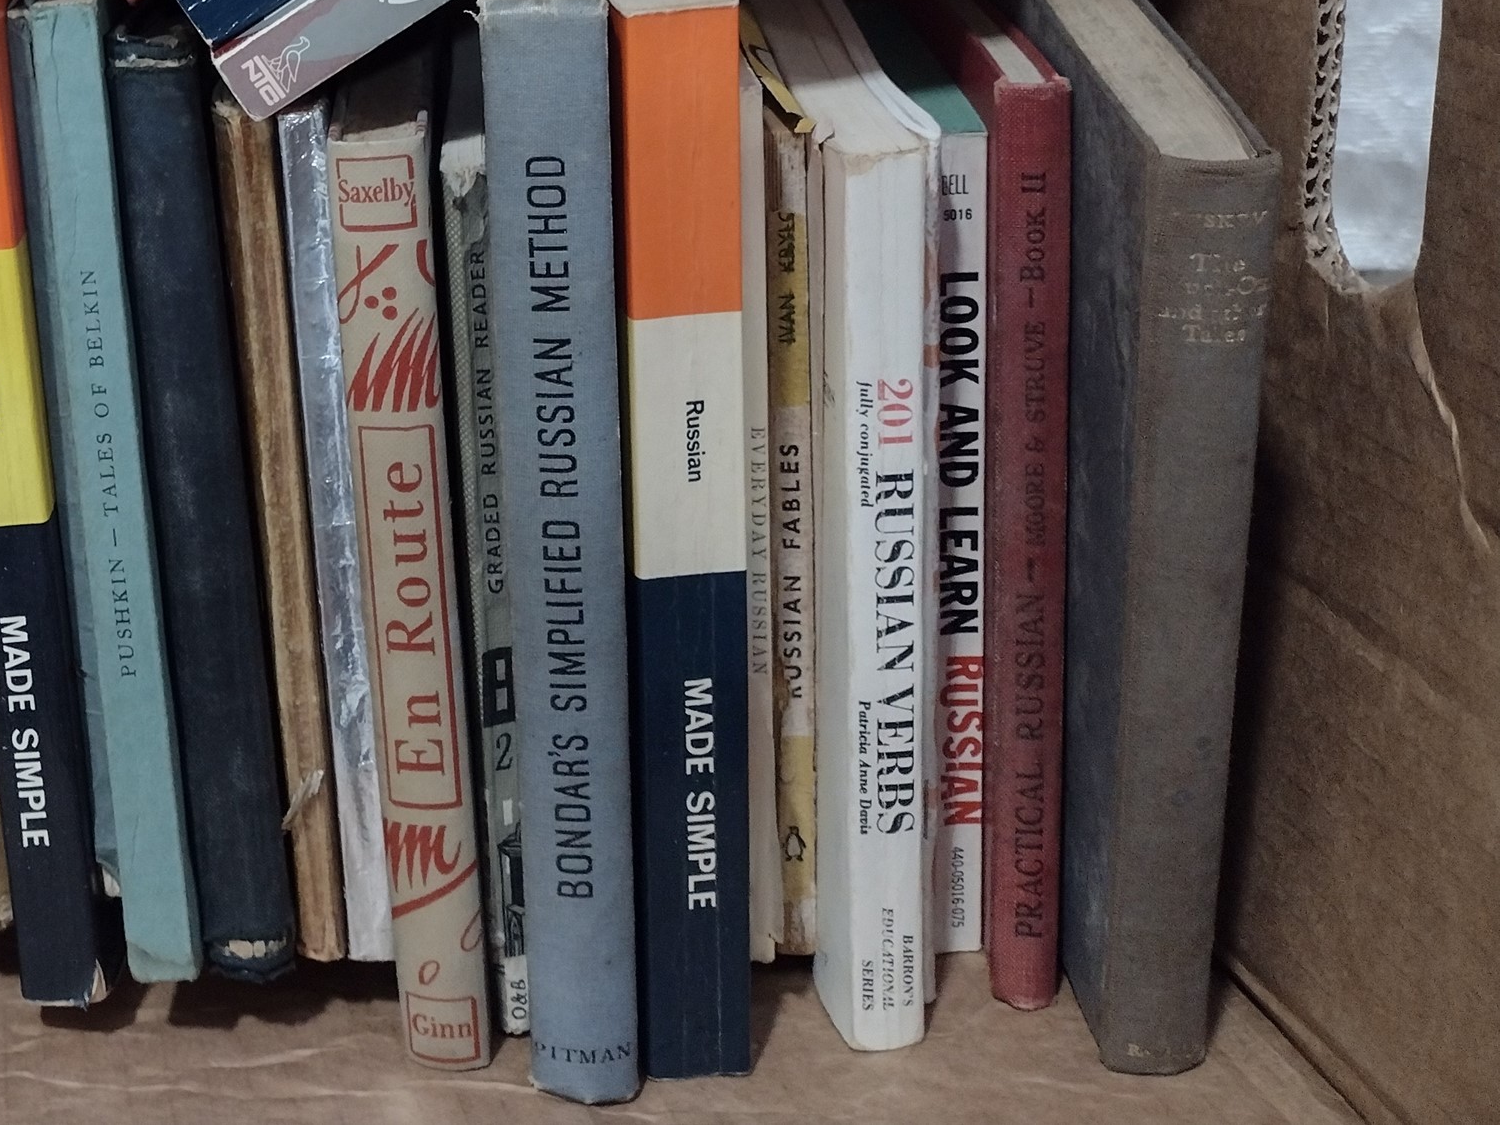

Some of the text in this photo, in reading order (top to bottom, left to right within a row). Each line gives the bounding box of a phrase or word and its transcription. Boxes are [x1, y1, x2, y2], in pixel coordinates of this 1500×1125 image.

[338, 177, 415, 208] Saxelby
[470, 250, 505, 595] GRADED RUSSIAN READER
[1024, 321, 1047, 422] STRUVE
[79, 268, 137, 678] PUSHKIN TALES OF BELKIN
[685, 398, 705, 484] Russian
[779, 442, 801, 550] FABLES
[854, 380, 875, 509] fully conjugated
[1025, 435, 1046, 453] &
[525, 155, 594, 900] BONDAR'S SIMPLIFIED RUSSIAN METHOD
[750, 426, 769, 677] EVERYDAY RUSSIAN
[938, 271, 984, 827] LOOK AND LEARN RUSSIAN
[1025, 462, 1047, 548] MOORE
[383, 459, 446, 777] En Route
[874, 378, 916, 836] 201 RUSSIAN VERBS
[1014, 592, 1046, 742] RUSSIAN
[0, 614, 51, 850] MADE SIMPLE
[495, 732, 514, 772] 2
[857, 700, 873, 836] Patricia Anne Davis
[683, 678, 717, 910] MADE SIMPLE
[1014, 762, 1046, 940] PRACTICAL
[511, 977, 529, 1021] O&B
[861, 958, 875, 1012] SERIES
[880, 907, 896, 1012] EDUCATIONAL
[901, 933, 913, 1008] BARRON'S
[412, 1015, 474, 1040] Ginn
[532, 1040, 632, 1066] PITMAN
